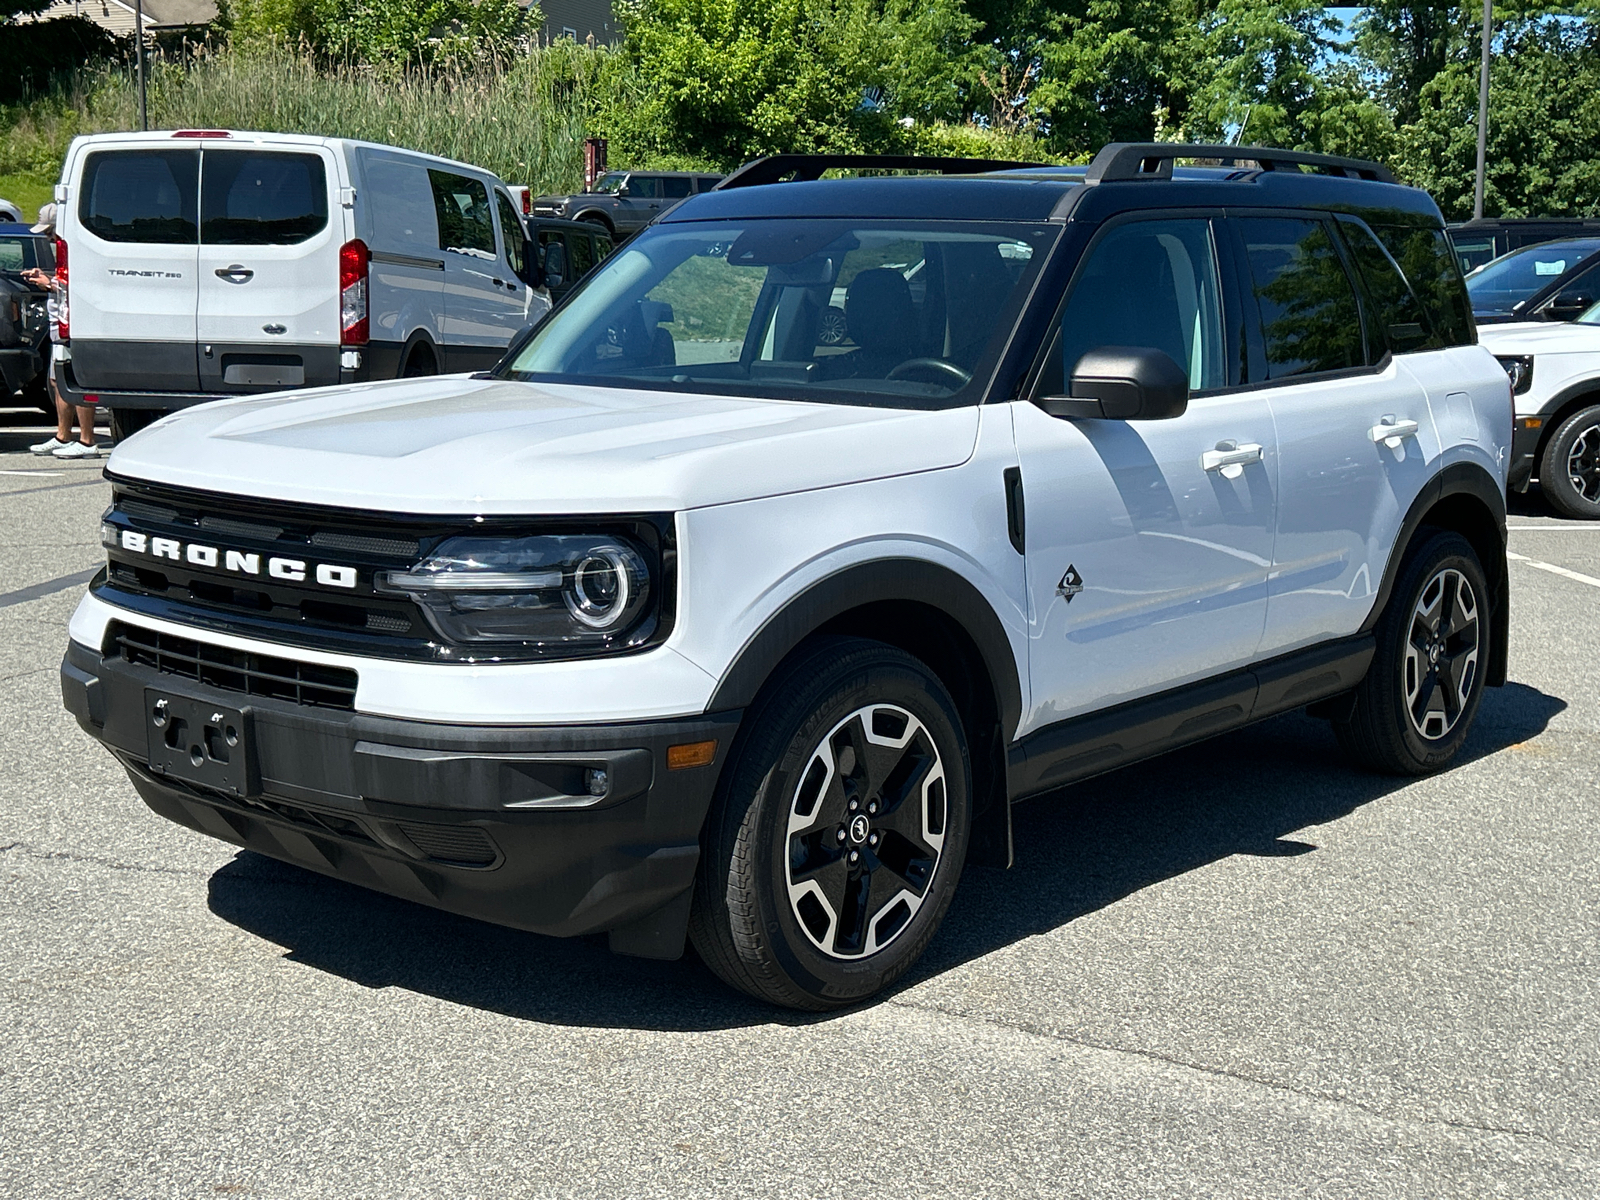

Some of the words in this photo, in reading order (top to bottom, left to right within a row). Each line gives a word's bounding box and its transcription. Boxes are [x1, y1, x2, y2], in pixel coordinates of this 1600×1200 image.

[108, 269, 164, 278] TRANSIT
[122, 530, 357, 588] BRONCO
[804, 674, 869, 734] MICHELIN
